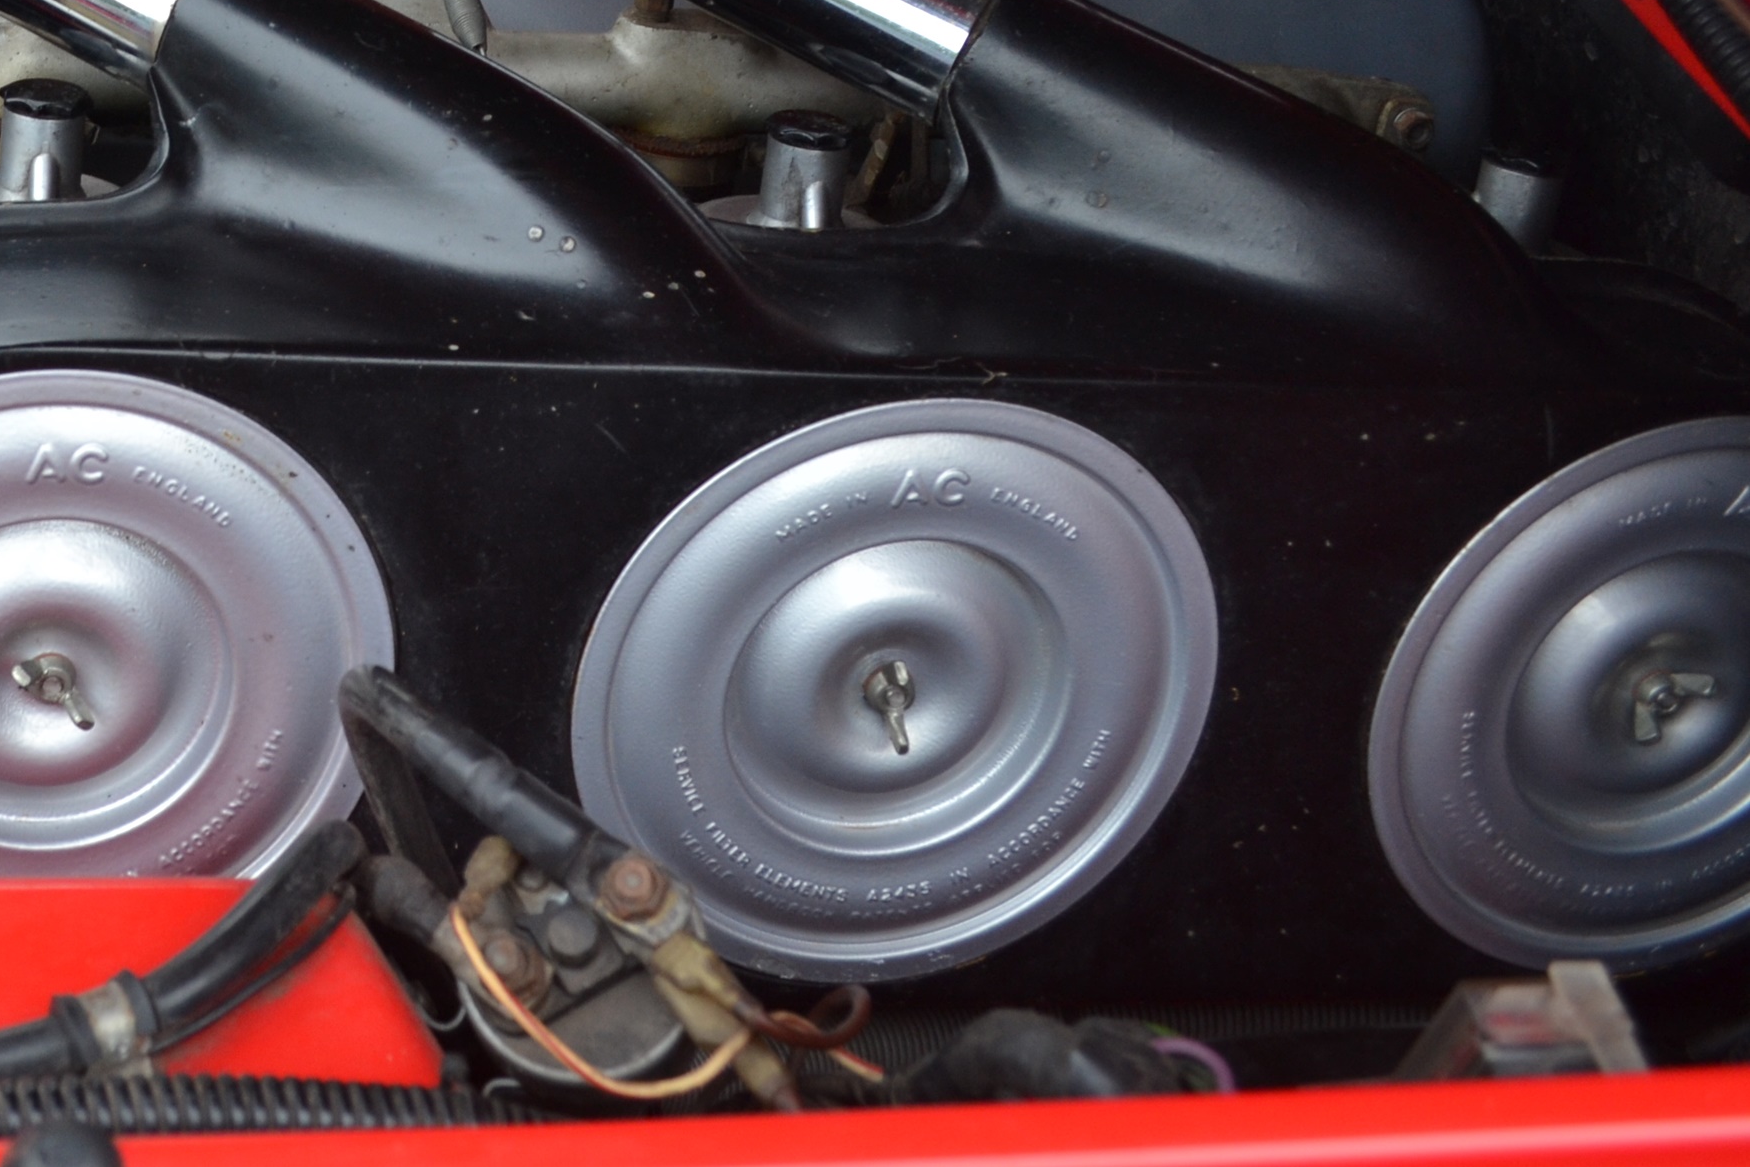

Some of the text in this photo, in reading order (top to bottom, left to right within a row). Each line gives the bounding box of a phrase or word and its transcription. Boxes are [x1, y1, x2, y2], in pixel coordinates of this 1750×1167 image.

[25, 441, 110, 485] AC
[890, 467, 971, 510] AC
[131, 465, 234, 529] ENGLAND
[774, 486, 1081, 543] MADE IN ENGLAND
[159, 778, 259, 867] ACCORDANCE
[255, 729, 284, 771] WITH
[672, 745, 705, 817] SERVICE
[705, 821, 752, 868] FILTER
[754, 863, 849, 903] ELEMENTS
[986, 777, 1086, 868] ACCORDANCE
[1082, 729, 1112, 771] WITH
